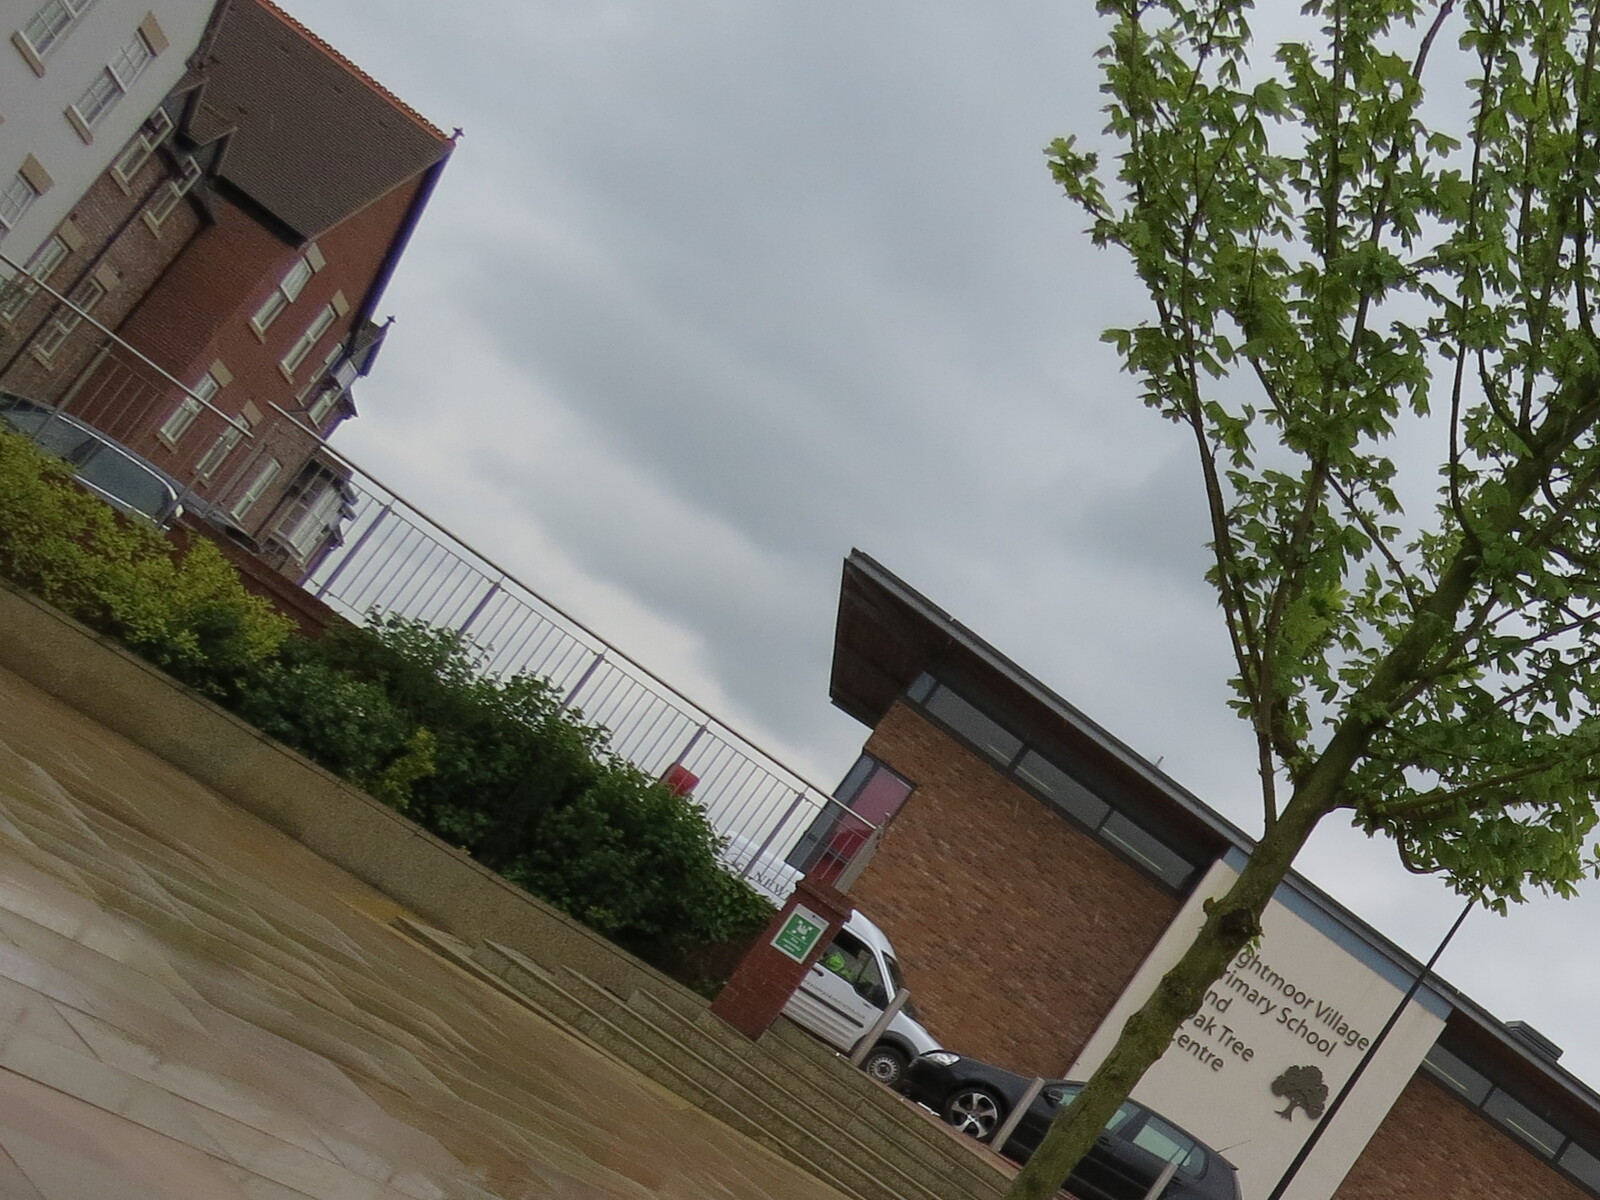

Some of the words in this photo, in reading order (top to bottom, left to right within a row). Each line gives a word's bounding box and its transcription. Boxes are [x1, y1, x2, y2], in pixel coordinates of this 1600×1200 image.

[1204, 989, 1233, 1013] nd
[1225, 969, 1277, 1015] imary
[1276, 1007, 1338, 1057] School
[1234, 951, 1314, 1009] ghtmoor
[1315, 1000, 1370, 1051] Village
[1217, 1024, 1254, 1062] Tree
